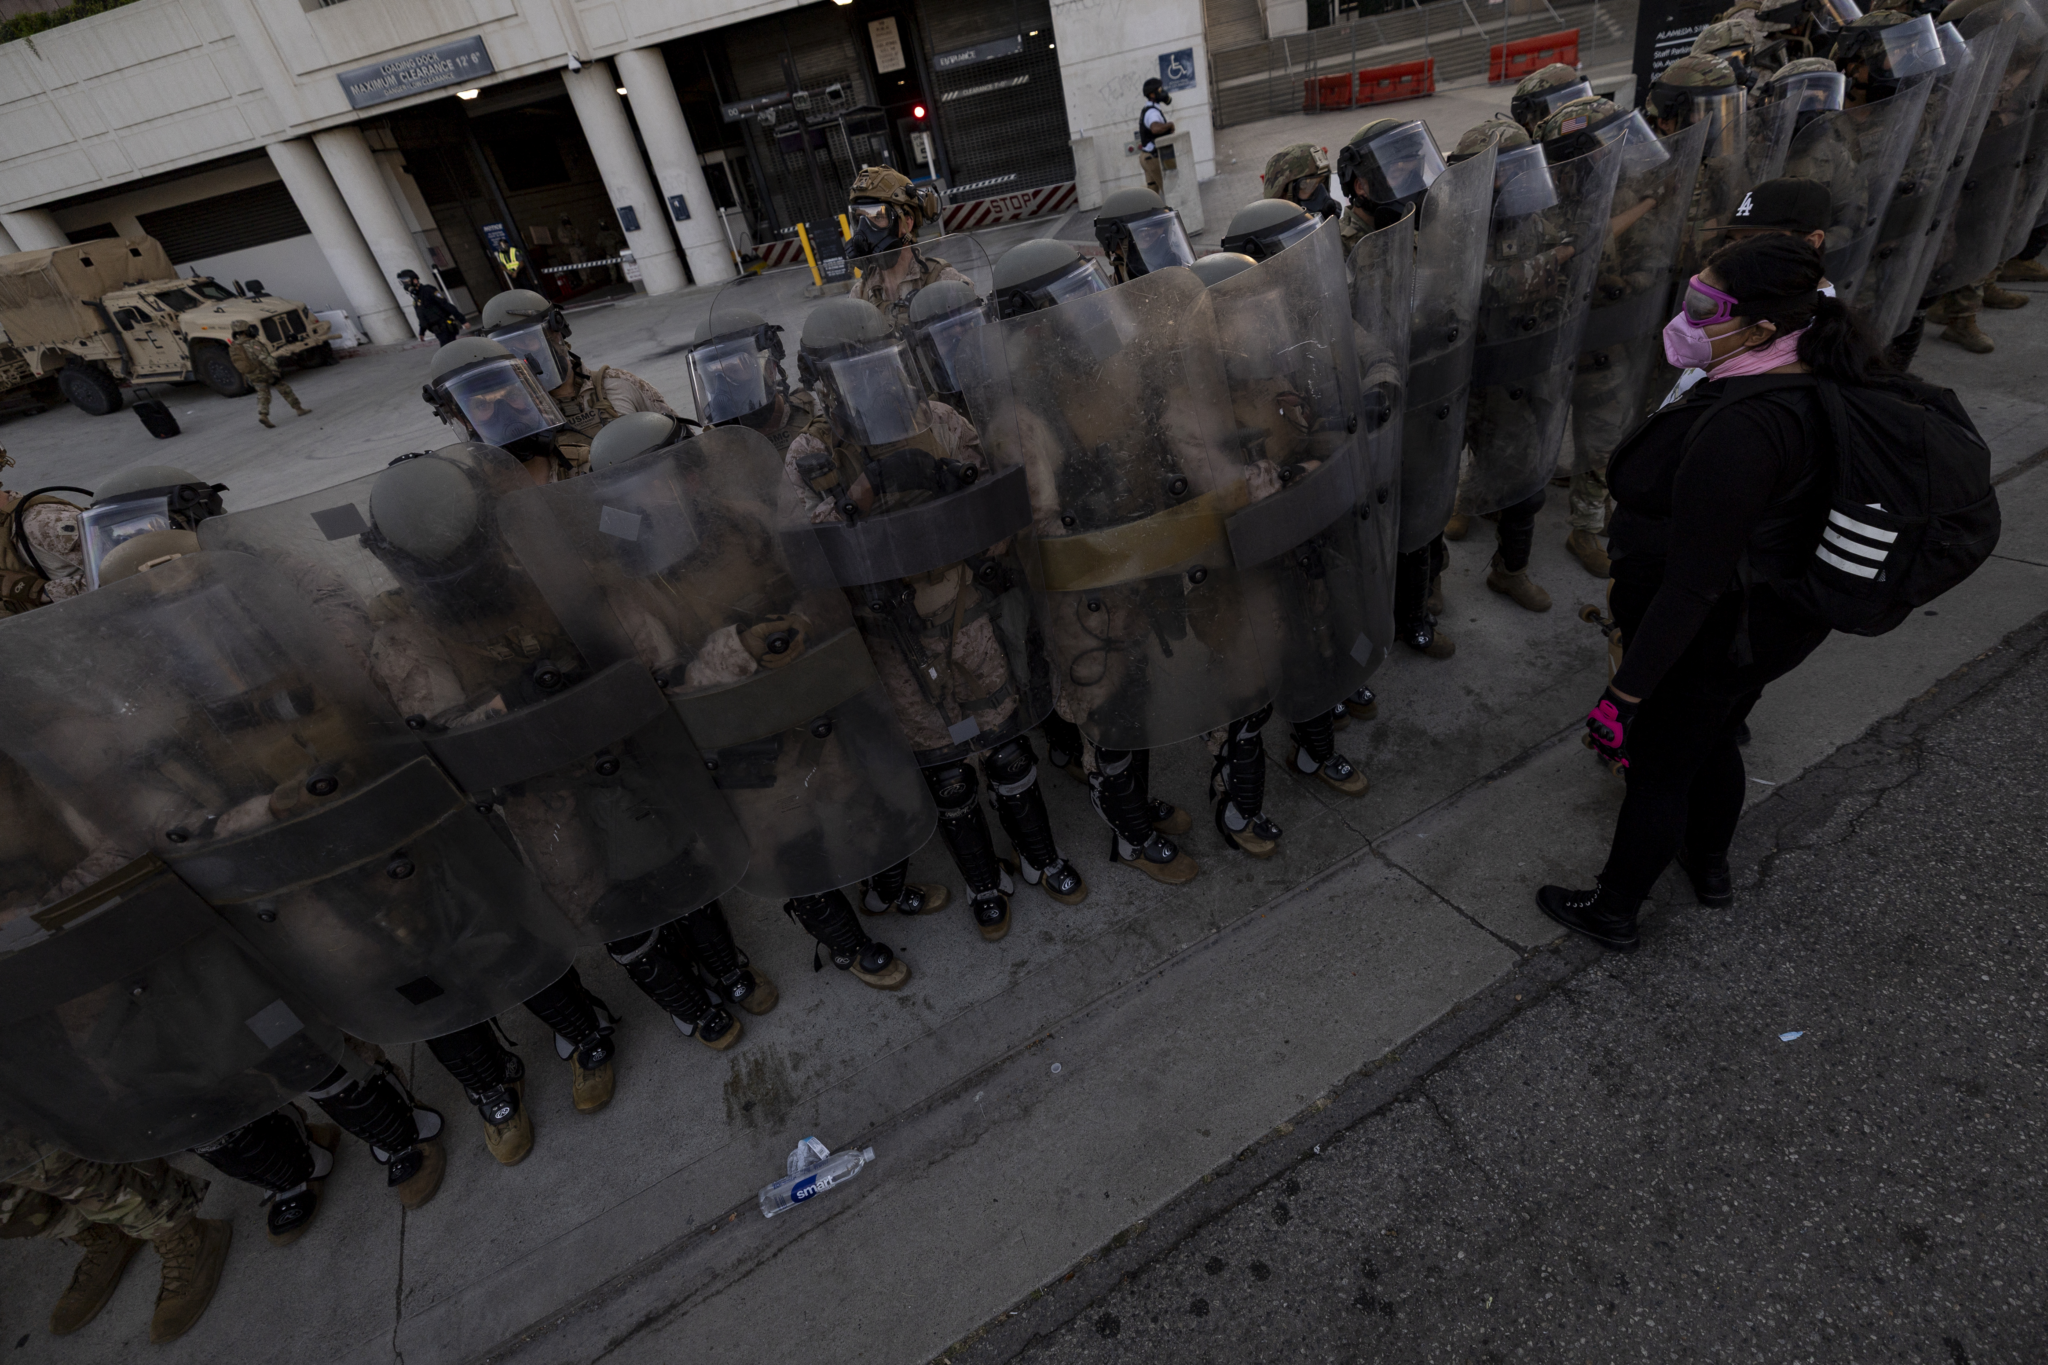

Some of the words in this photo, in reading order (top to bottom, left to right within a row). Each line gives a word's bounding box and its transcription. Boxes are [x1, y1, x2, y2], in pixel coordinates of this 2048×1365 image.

[940, 50, 976, 66] ENTRANCE
[1653, 48, 1671, 60] Staff
[1671, 45, 1693, 56] Parkin
[380, 59, 415, 76] LOADING
[416, 52, 440, 65] DOCK
[350, 75, 398, 96] MAXIMUM
[400, 59, 455, 83] CLEARANCE
[422, 72, 455, 86] CLEARANCE
[962, 83, 993, 95] CLEARANCE
[990, 193, 1031, 213] STOP
[1735, 191, 1754, 217] LA
[568, 410, 596, 425] USMC
[767, 430, 790, 443] SMC
[796, 1175, 834, 1199] smart
